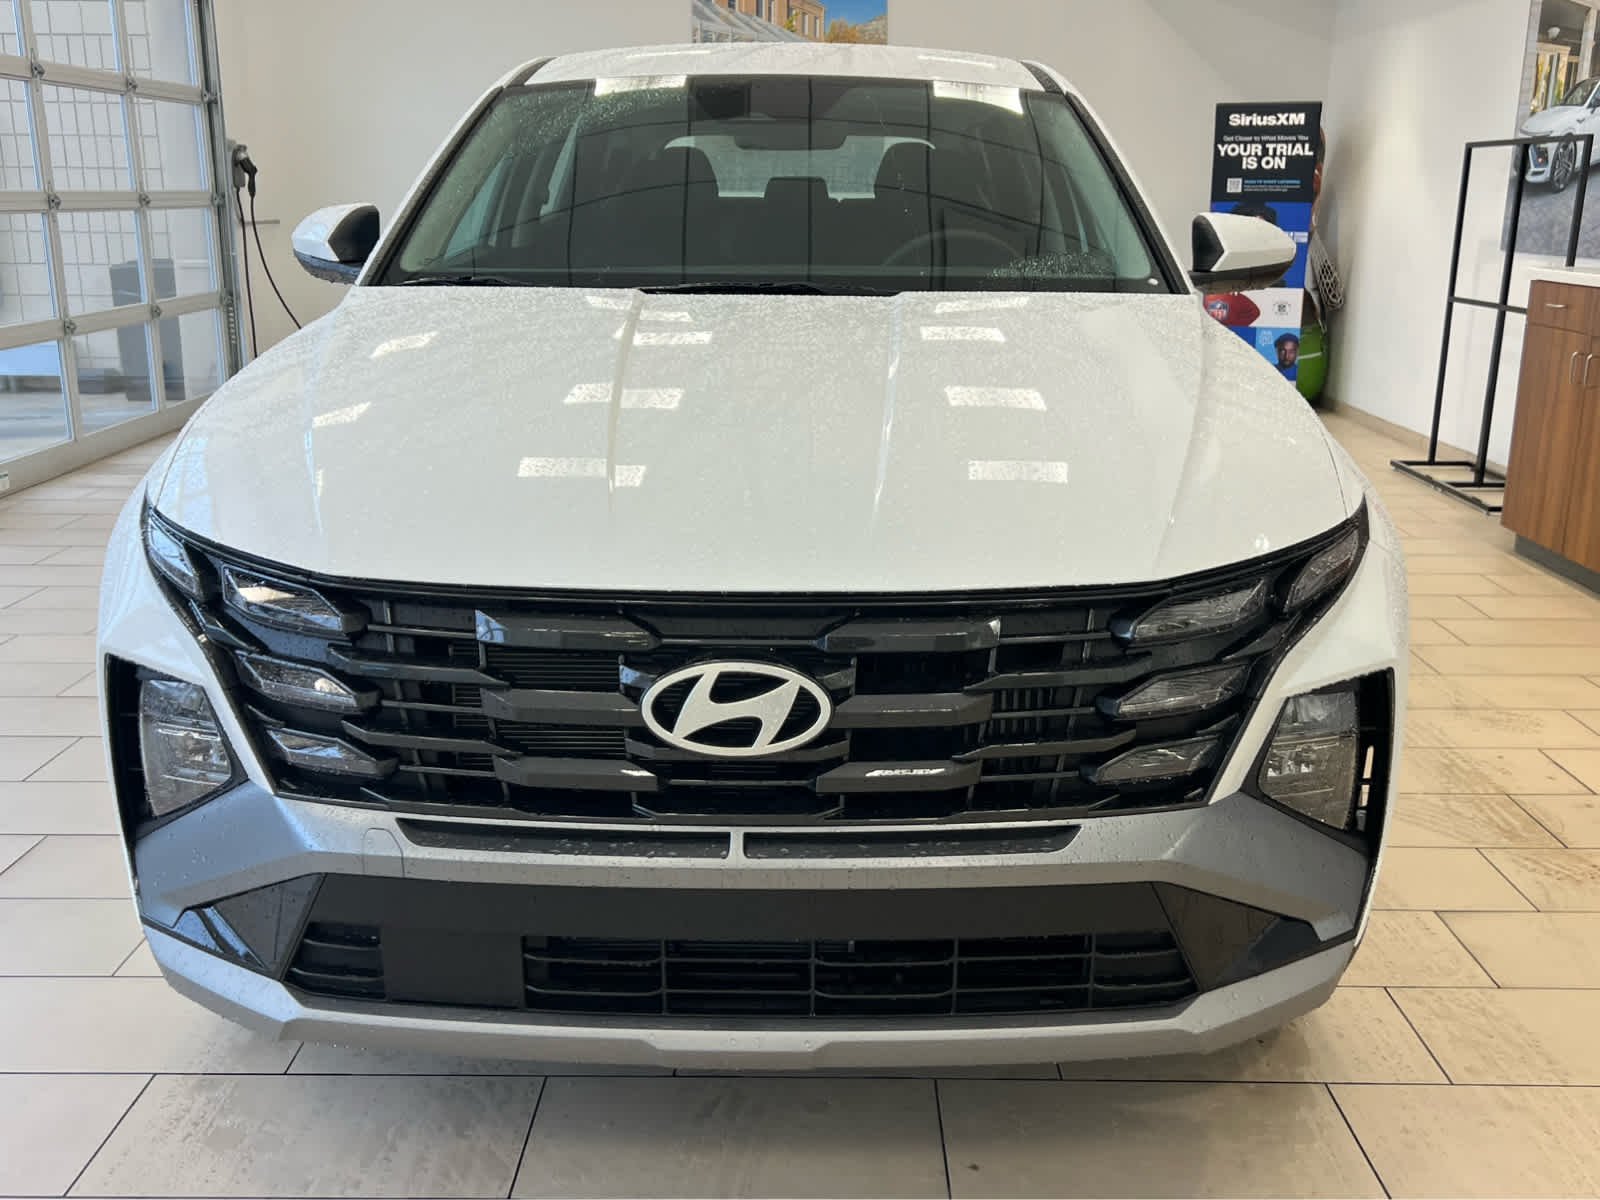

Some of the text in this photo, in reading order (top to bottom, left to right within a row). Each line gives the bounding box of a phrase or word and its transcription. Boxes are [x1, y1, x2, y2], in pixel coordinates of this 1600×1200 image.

[1228, 113, 1305, 126] SiriusXM
[1217, 143, 1314, 156] YOUR TRIAL
[1242, 156, 1286, 169] IS ON
